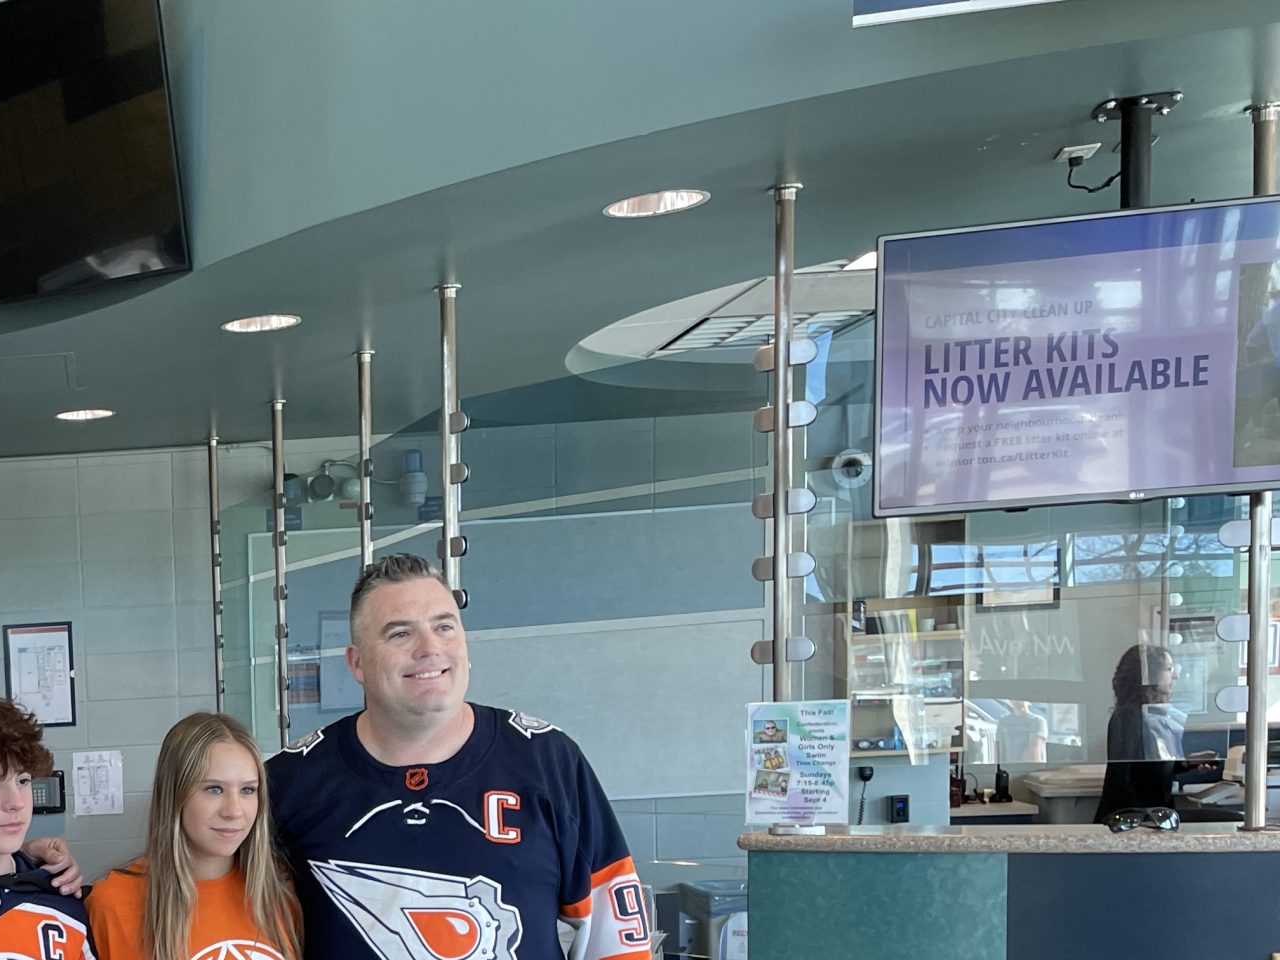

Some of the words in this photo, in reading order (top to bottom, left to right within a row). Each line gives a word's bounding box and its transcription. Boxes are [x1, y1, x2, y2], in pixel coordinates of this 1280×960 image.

[925, 312, 982, 328] CAPITAL
[987, 309, 1018, 323] CITY
[1023, 303, 1068, 319] CLEAN
[1074, 300, 1093, 315] UP
[924, 336, 1033, 375] LITTER
[1046, 328, 1119, 364] KITS
[923, 371, 1011, 409] NOW
[1021, 354, 1210, 401] AVAILABLE
[967, 423, 994, 436] your
[995, 436, 1023, 446] FREE
[1025, 434, 1052, 444] litter
[1055, 432, 1071, 442] kit
[818, 743, 835, 752] Only
[801, 788, 831, 796] Starting
[483, 789, 522, 845] C
[608, 879, 653, 948] 9
